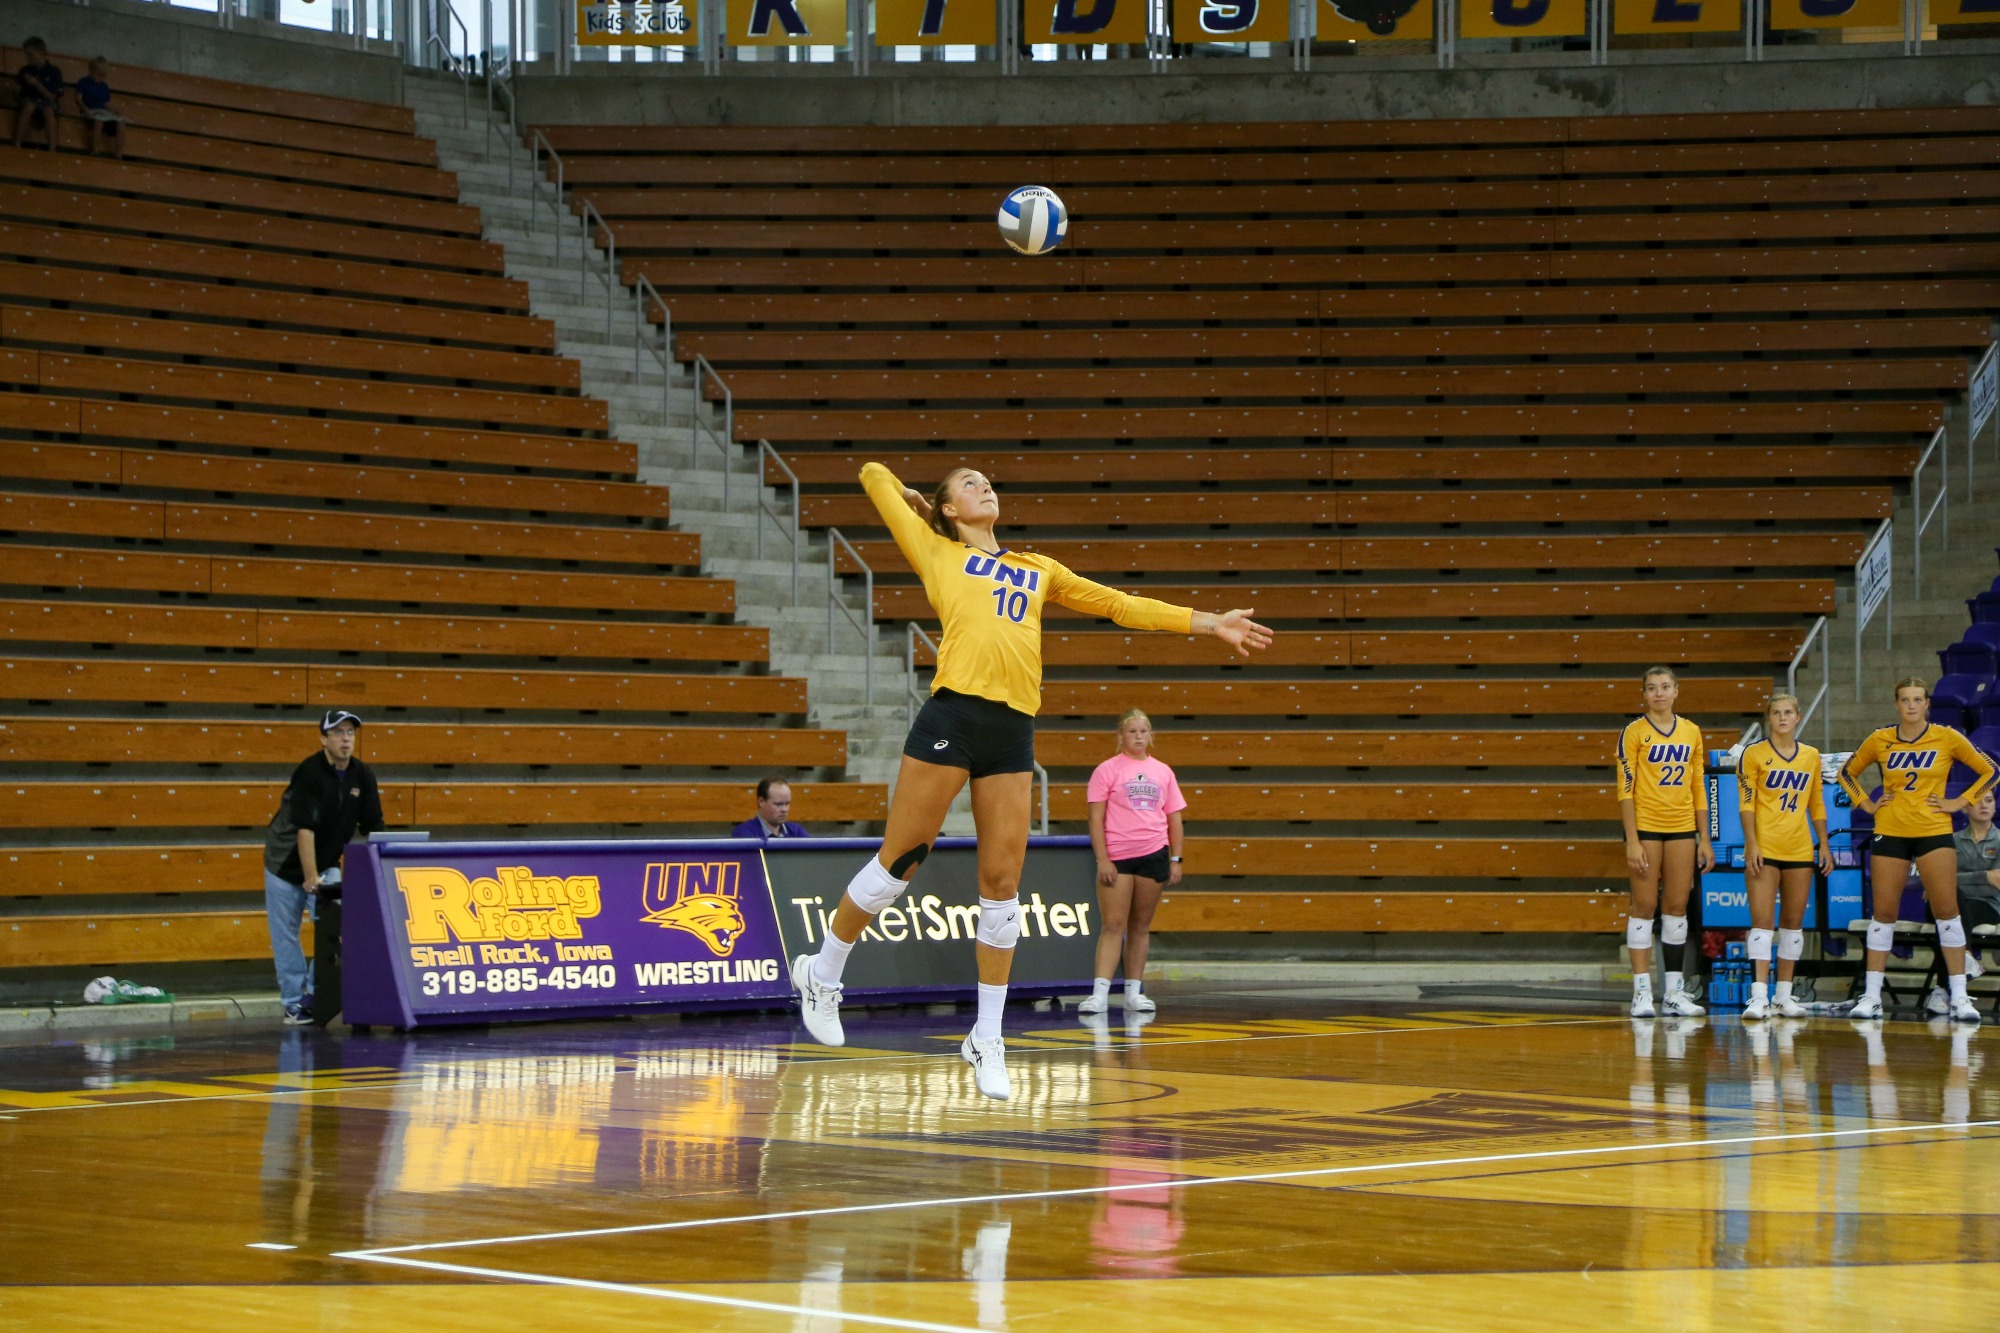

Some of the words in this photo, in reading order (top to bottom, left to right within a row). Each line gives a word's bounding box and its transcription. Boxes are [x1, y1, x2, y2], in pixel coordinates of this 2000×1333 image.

[586, 11, 627, 34] Kids
[647, 10, 692, 33] Club
[963, 554, 1040, 593] UNI
[992, 586, 1028, 623] 10
[1647, 743, 1691, 764] UNI
[1886, 750, 1939, 770] UNI
[1658, 765, 1685, 786] 22
[1765, 769, 1810, 791] UNI
[1903, 771, 1918, 791] 2
[1710, 778, 1719, 839] POWERADE
[1779, 792, 1798, 813] 14
[642, 862, 741, 914] UNI
[394, 866, 602, 943] Roling
[791, 893, 1090, 943] TietSmrter
[478, 906, 584, 941] Ford
[411, 944, 474, 968] Shell
[481, 943, 549, 965] Rock,
[556, 941, 613, 961] Iowa
[422, 964, 616, 996] 319-885-4540
[634, 959, 779, 987] WRESTLING
